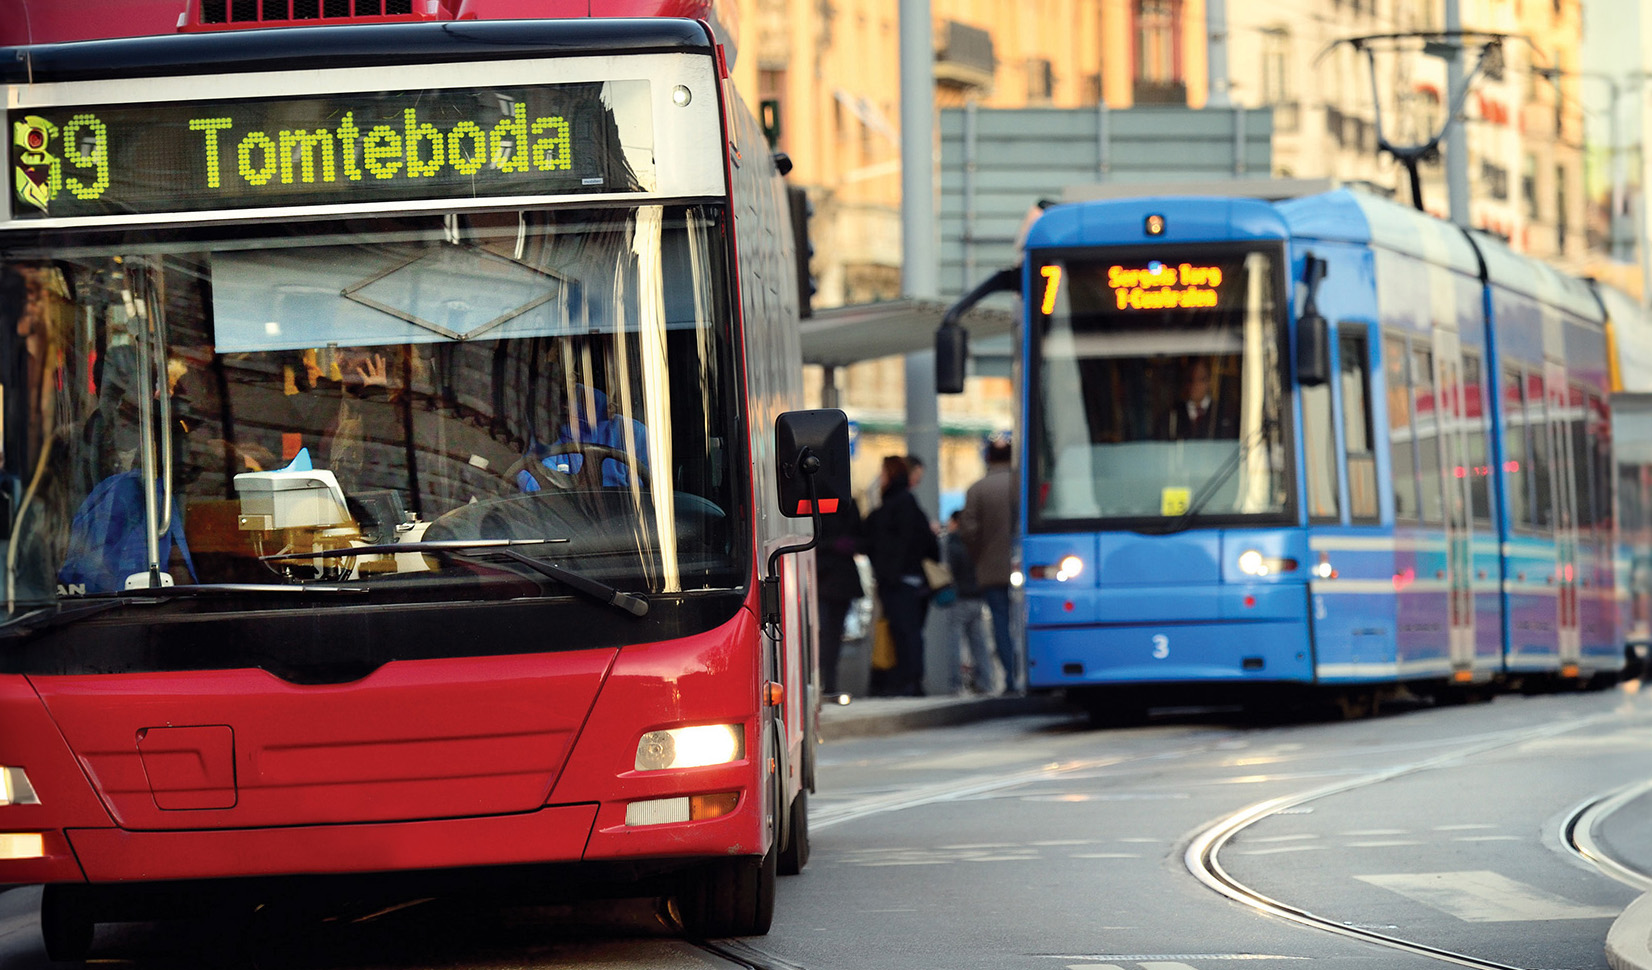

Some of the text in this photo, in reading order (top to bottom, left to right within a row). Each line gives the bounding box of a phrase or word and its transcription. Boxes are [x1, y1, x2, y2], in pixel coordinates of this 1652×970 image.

[189, 102, 572, 188] Tomteboda
[1040, 265, 1062, 315] 7
[56, 583, 86, 596] AN
[1152, 633, 1170, 659] 3
